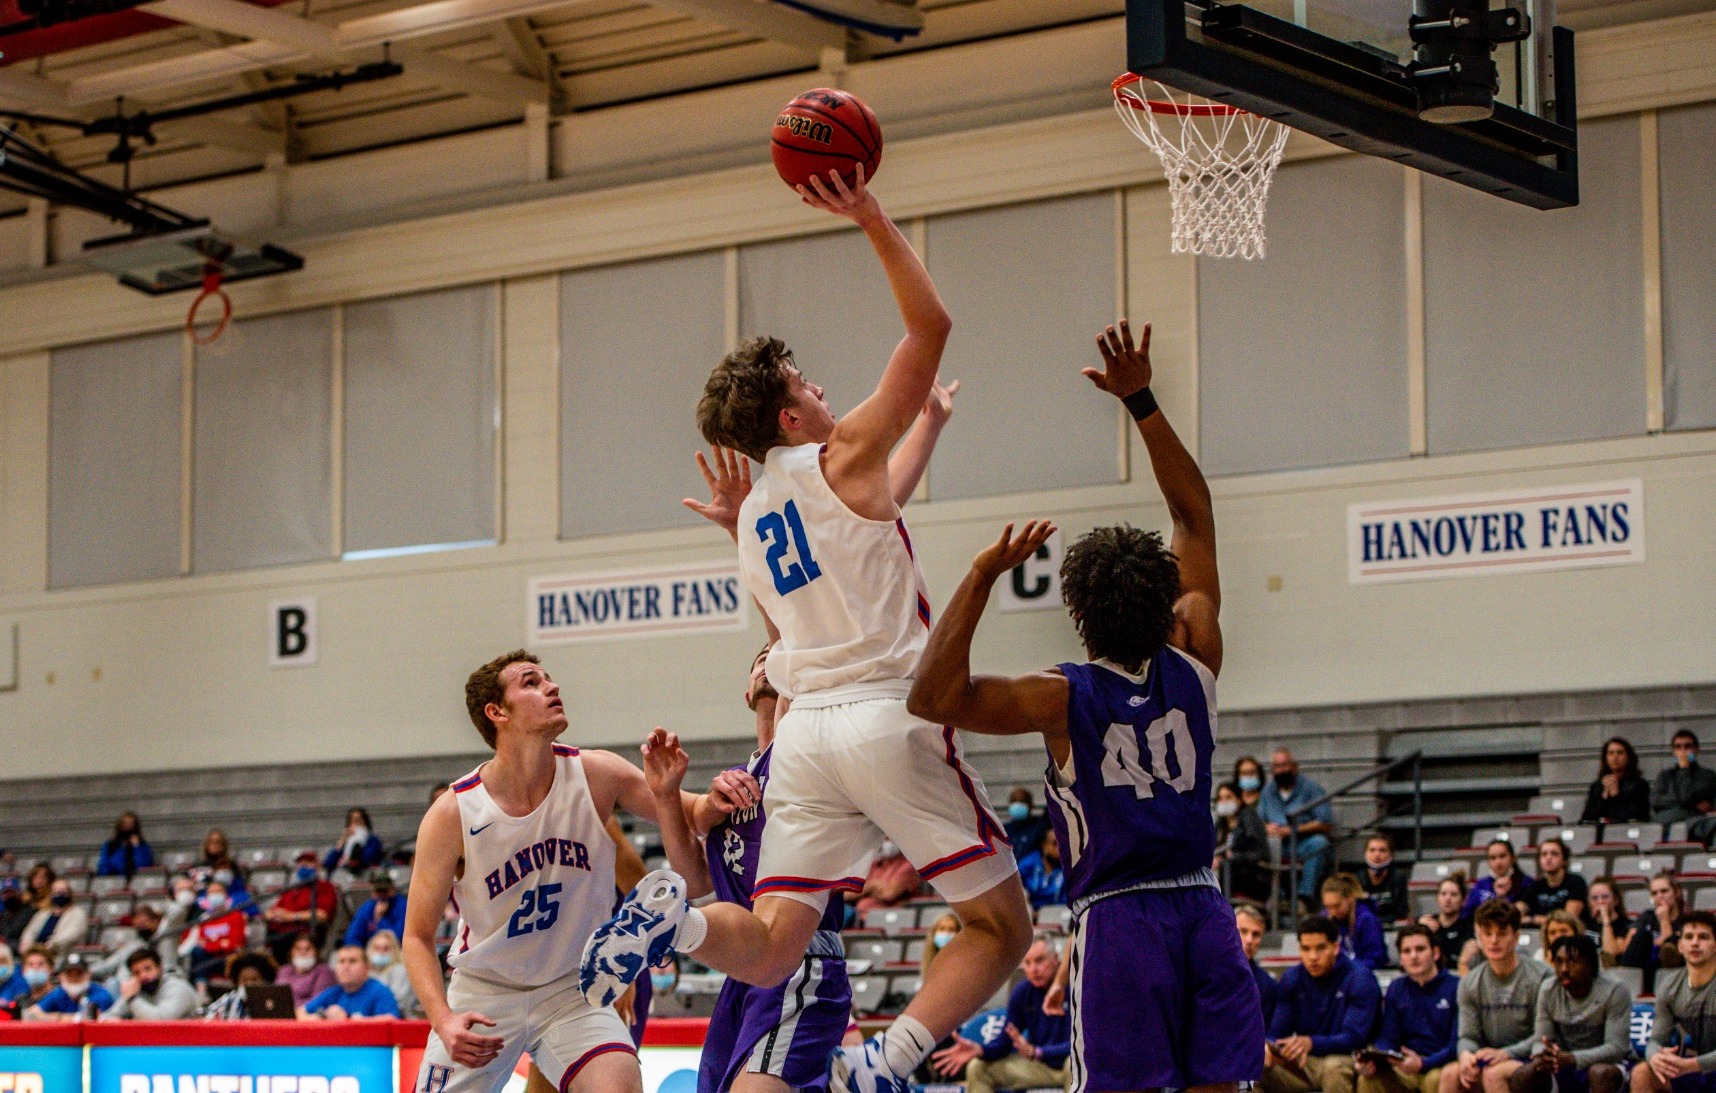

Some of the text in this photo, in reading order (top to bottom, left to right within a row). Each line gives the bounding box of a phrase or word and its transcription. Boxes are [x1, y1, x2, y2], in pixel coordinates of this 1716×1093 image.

[755, 498, 823, 597] 21
[1361, 501, 1631, 563] HANOVER FANS
[1012, 543, 1050, 599] C
[278, 606, 307, 657] B
[538, 576, 739, 628] HANOVER FANS
[1100, 707, 1197, 800] 40
[484, 837, 592, 901] HANOVER
[507, 882, 562, 938] 25
